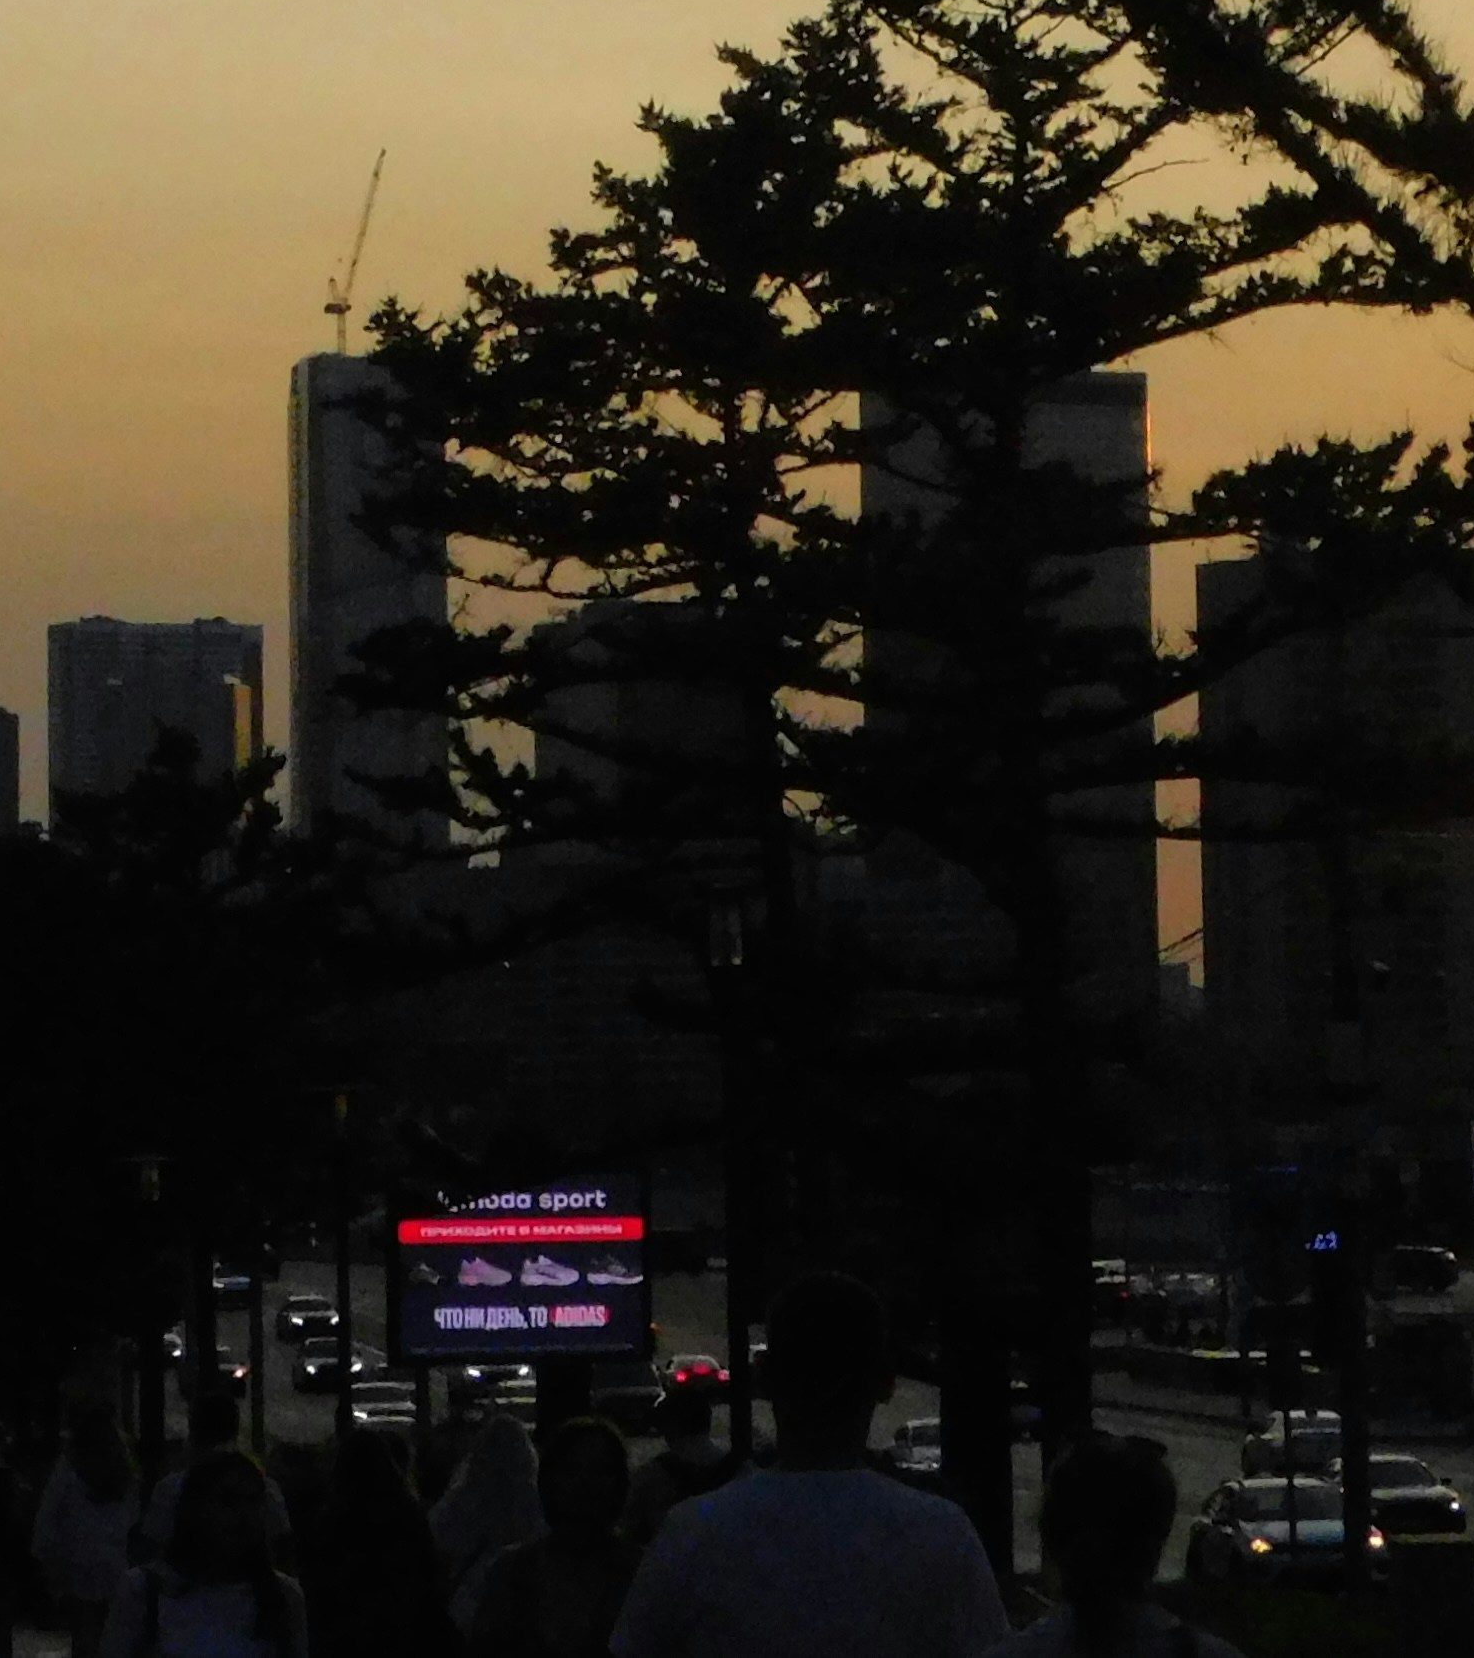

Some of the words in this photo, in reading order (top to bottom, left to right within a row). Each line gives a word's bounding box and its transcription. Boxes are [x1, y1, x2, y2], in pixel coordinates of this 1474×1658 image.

[538, 1189, 607, 1212] sport
[420, 1225, 516, 1237] ПРИХОДИТЕ
[532, 1223, 623, 1236] МАГАЗИНЫ
[434, 1306, 463, 1329] ЧТО
[528, 1306, 548, 1328] ТО
[555, 1305, 606, 1328] ADIDAS
